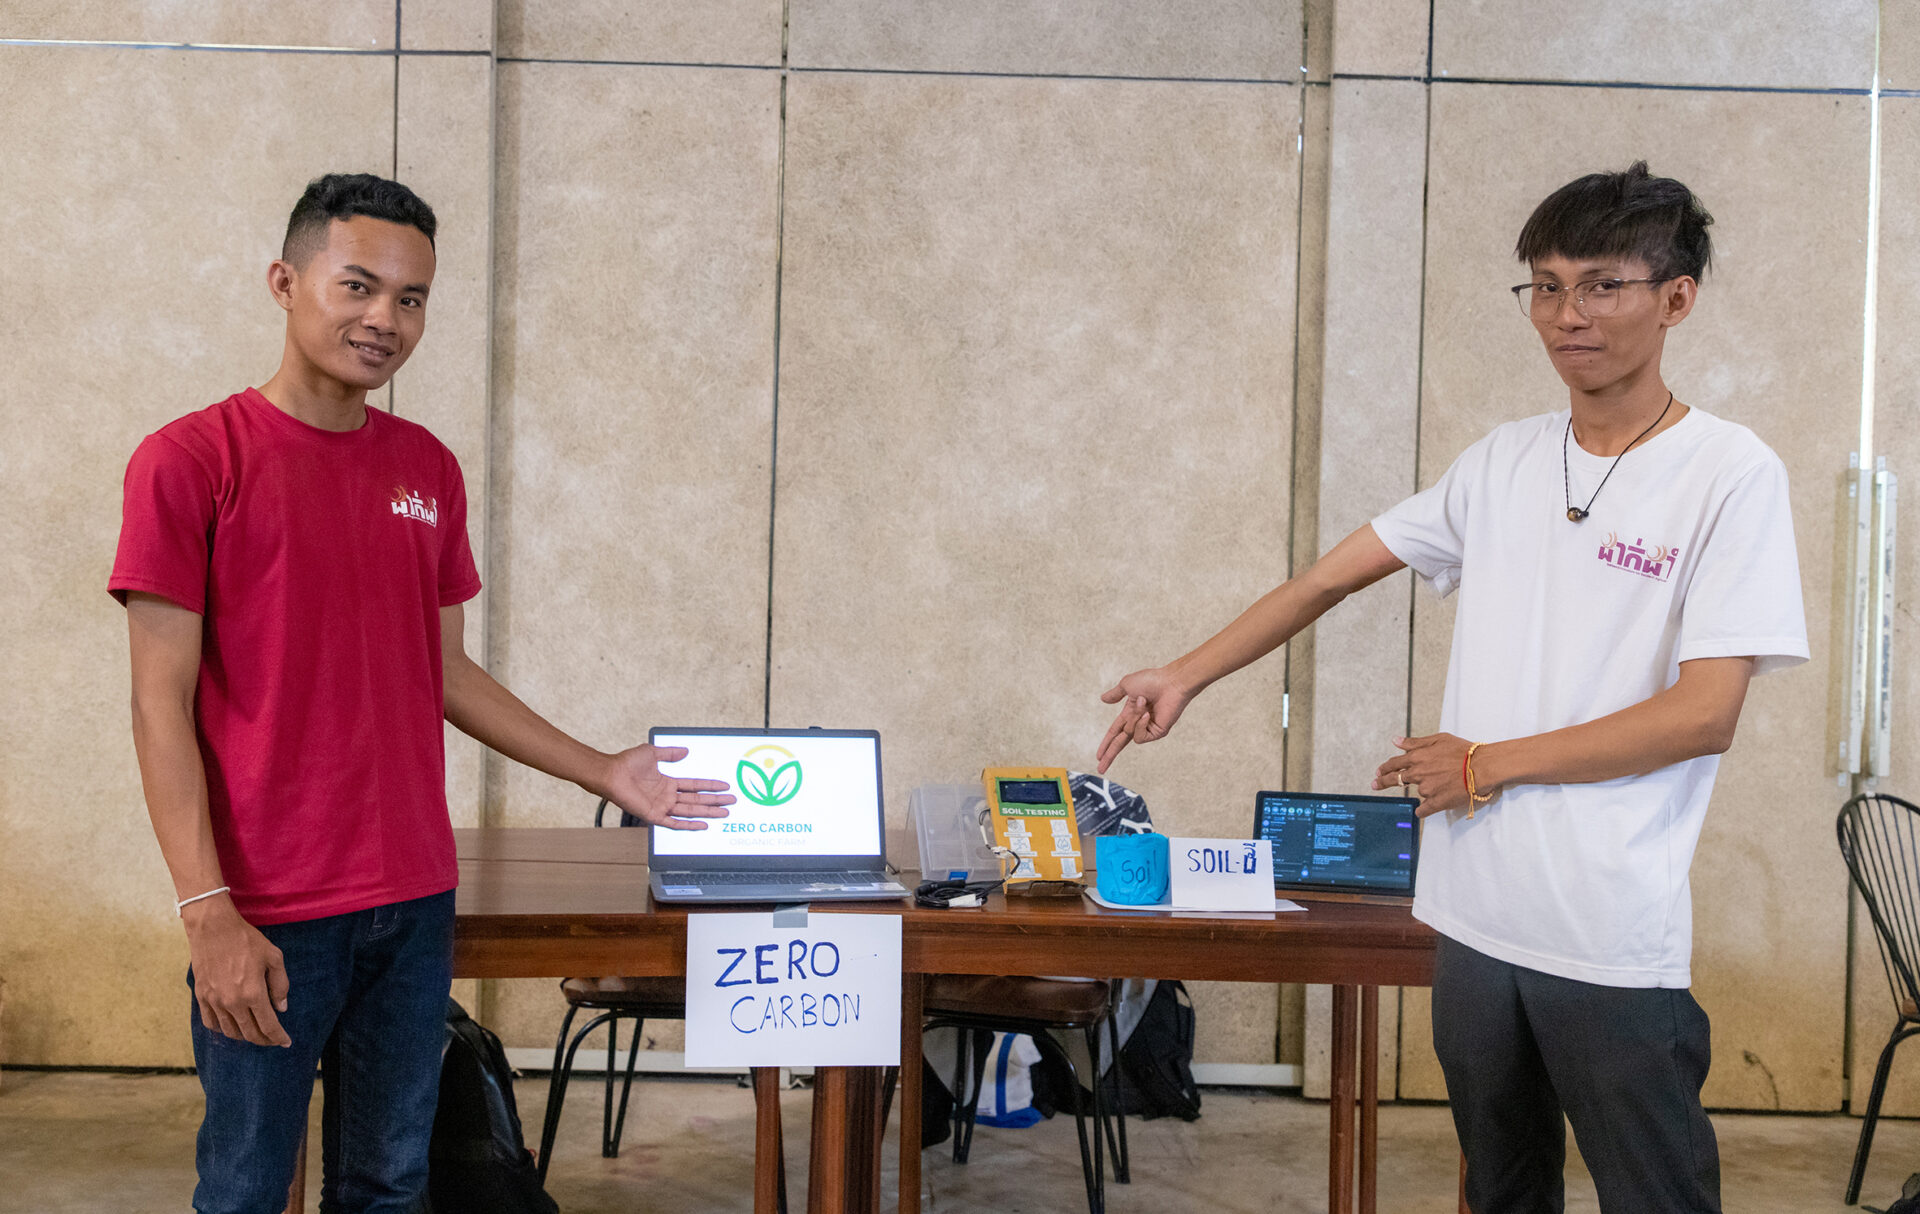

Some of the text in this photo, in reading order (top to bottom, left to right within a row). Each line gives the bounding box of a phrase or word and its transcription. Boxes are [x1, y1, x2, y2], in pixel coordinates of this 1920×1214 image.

[722, 823, 812, 833] ZERO CARBON
[1025, 808, 1066, 816] TESTING
[1121, 849, 1157, 885] Soil
[714, 939, 840, 987] ZERO
[730, 993, 860, 1034] CARBON
